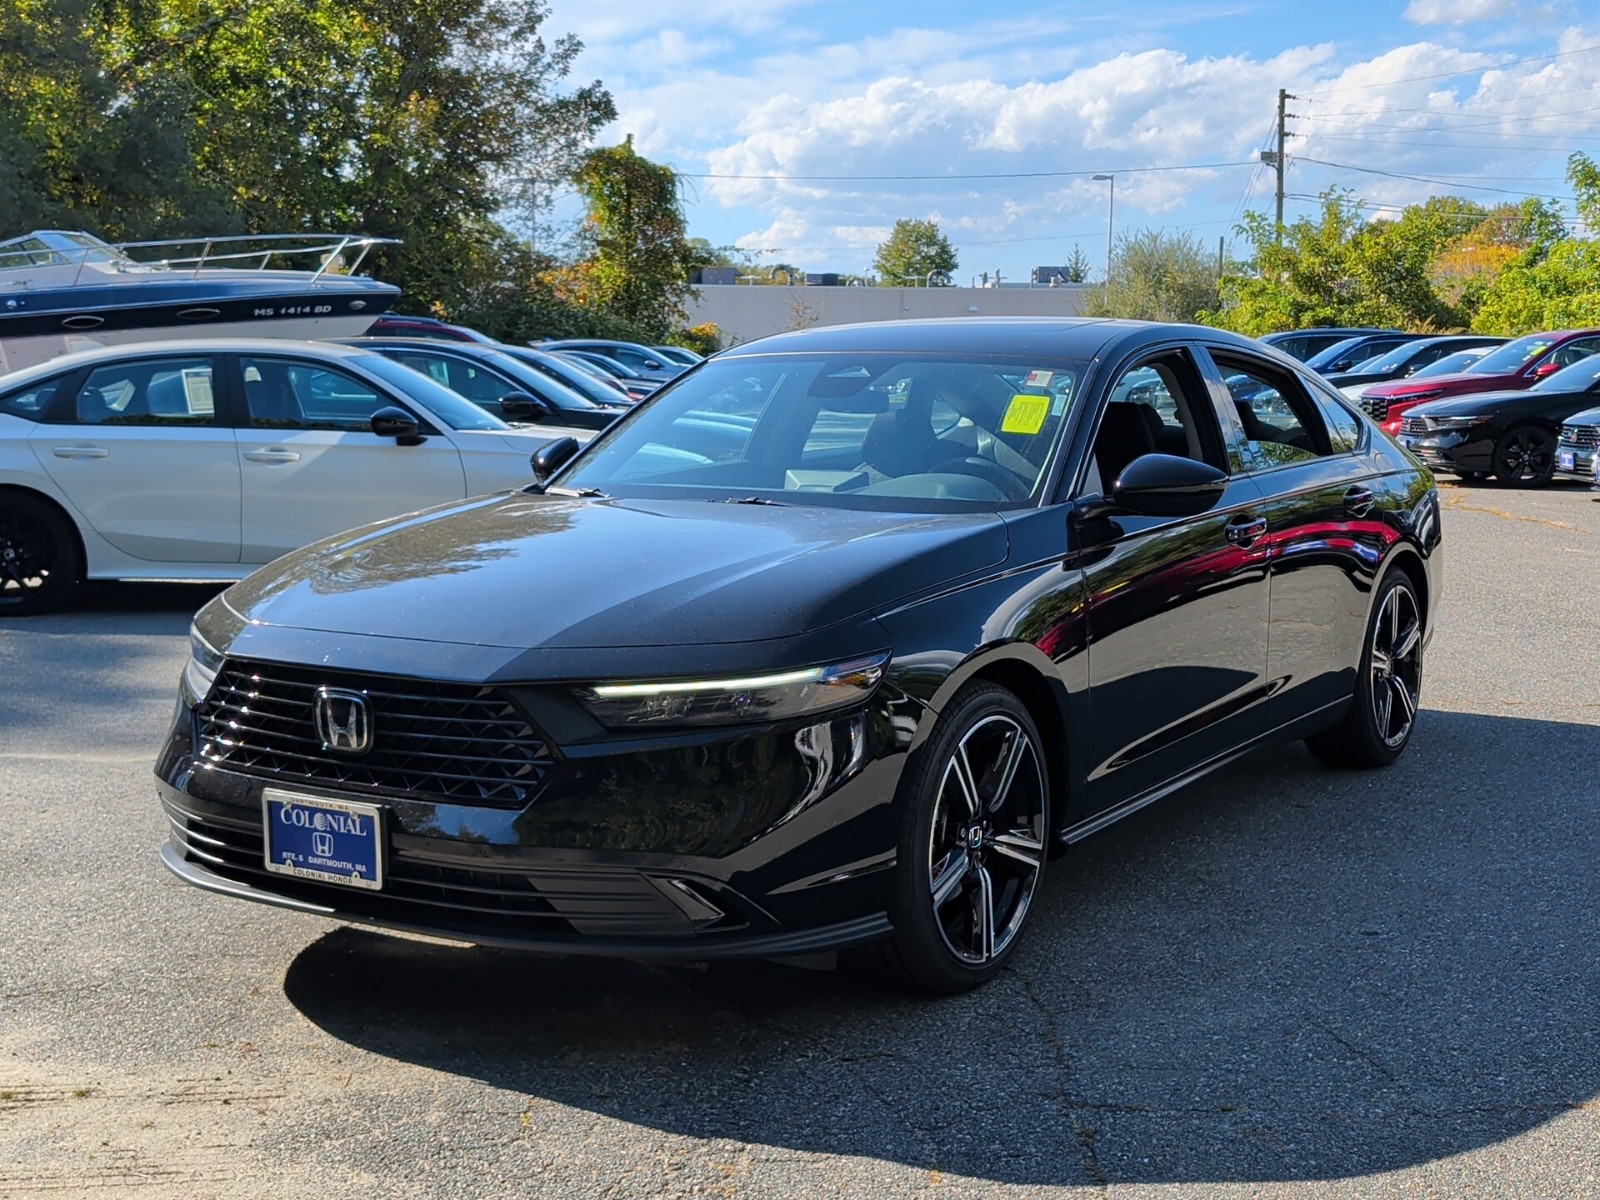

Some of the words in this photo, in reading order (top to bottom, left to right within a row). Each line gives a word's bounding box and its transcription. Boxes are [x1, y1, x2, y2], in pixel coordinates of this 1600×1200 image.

[254, 308, 274, 316] MS
[314, 304, 332, 313] BD
[280, 807, 367, 836] COLONIAL
[355, 863, 367, 873] MA
[293, 868, 326, 880] COLONIAL
[327, 874, 353, 885] HONDA
